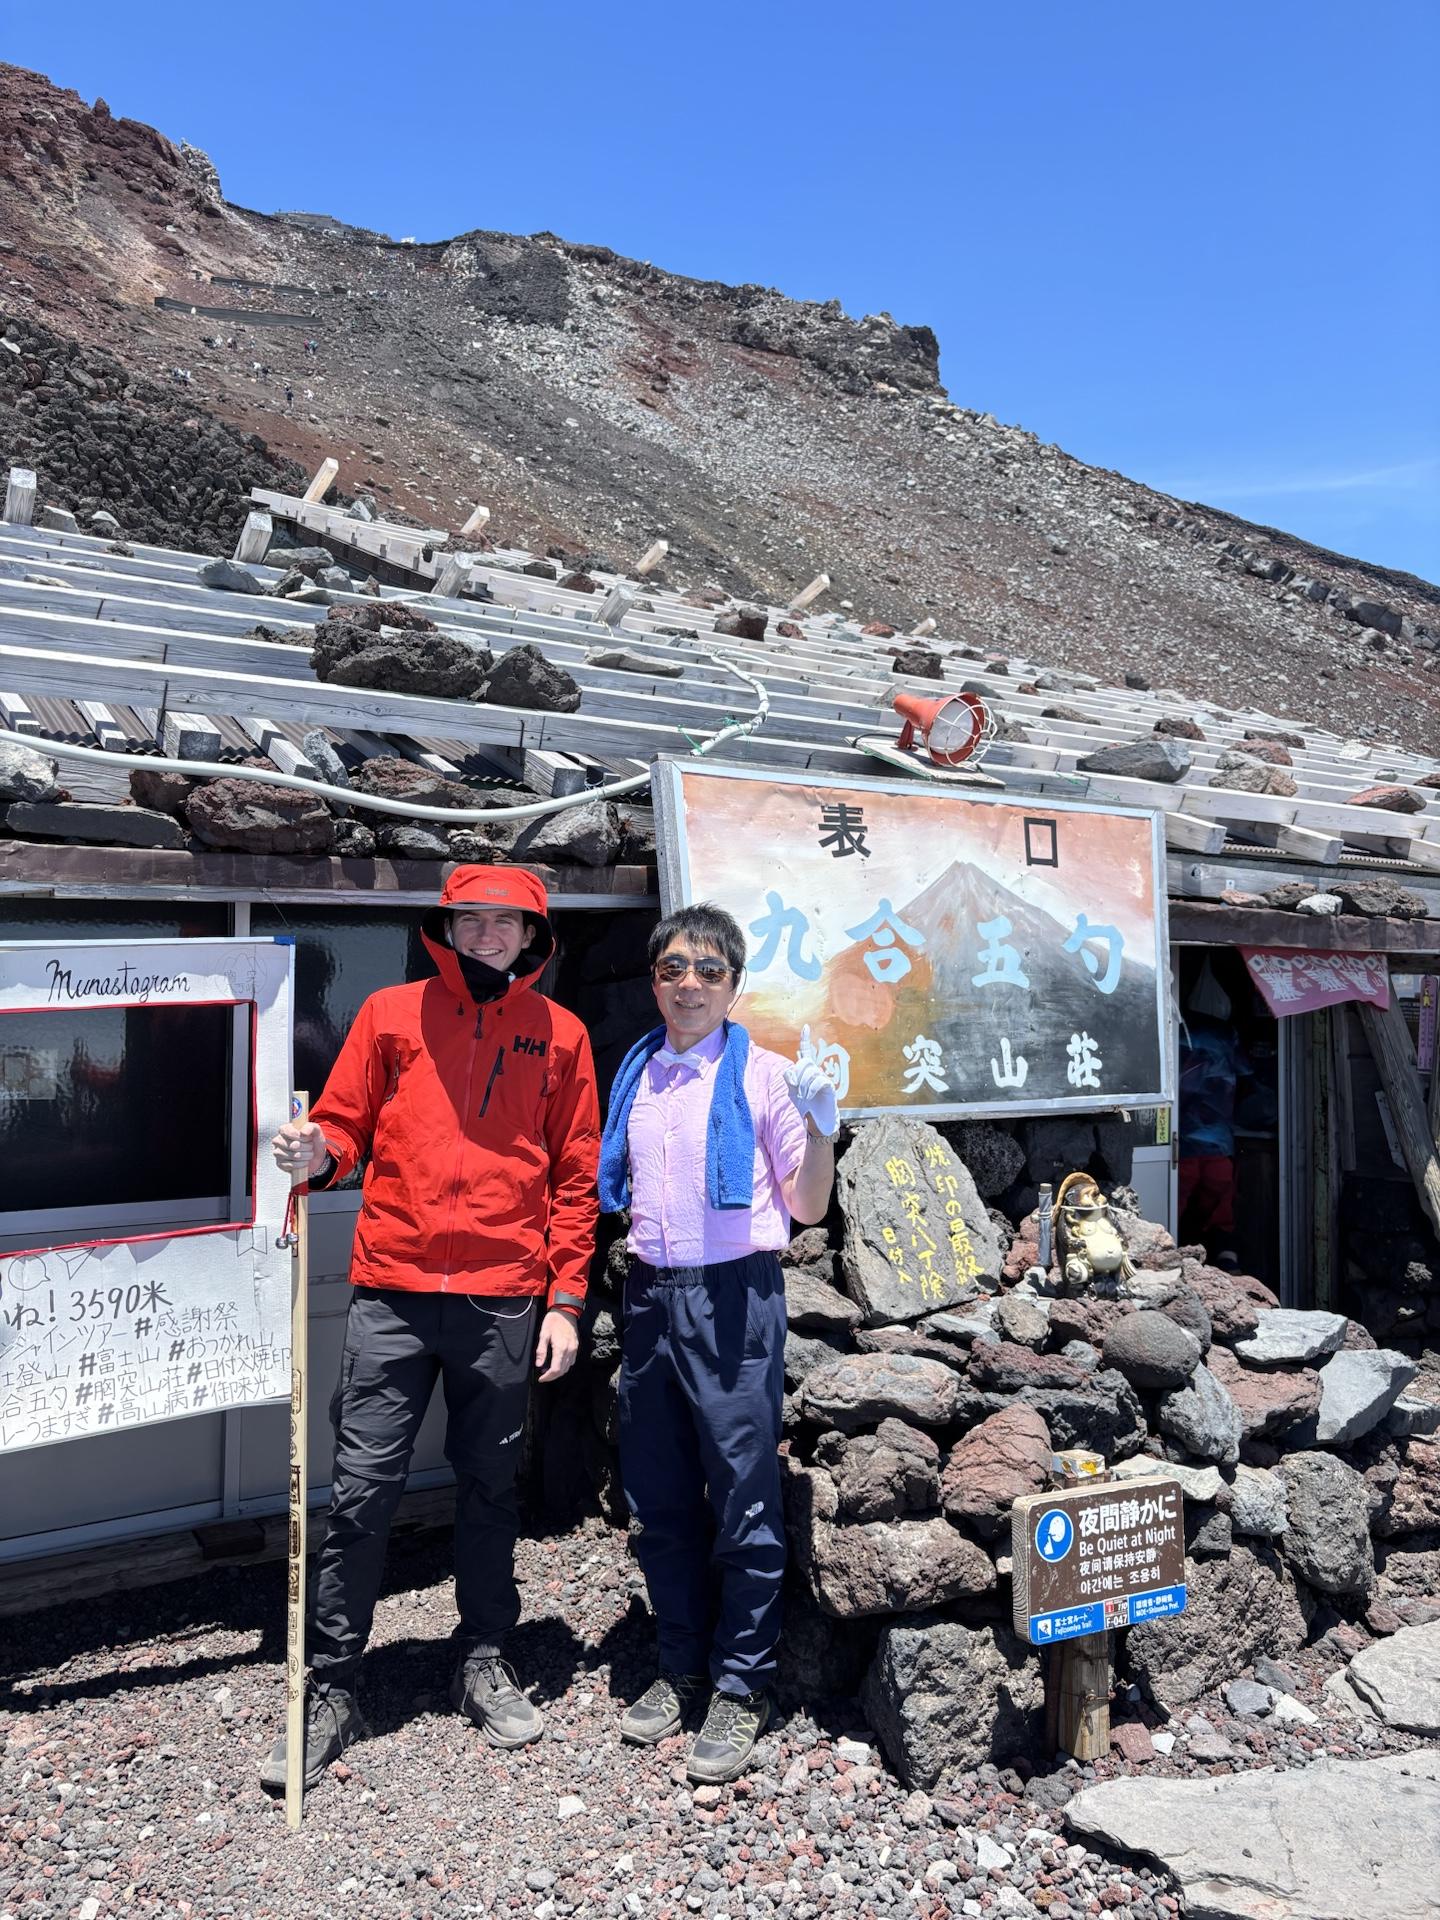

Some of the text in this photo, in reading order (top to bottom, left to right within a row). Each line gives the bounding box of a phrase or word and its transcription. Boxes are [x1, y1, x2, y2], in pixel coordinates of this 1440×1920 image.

[818, 803, 1059, 868] 表口
[748, 891, 1125, 994] 九合五勺
[45, 959, 190, 1003] Munastagram
[69, 1280, 173, 1322] 3590米
[79, 1346, 160, 1378] #富士山
[1078, 1494, 1177, 1538] 夜間静かに
[1079, 1526, 1176, 1557] Be Quiet at Night
[1079, 1548, 1157, 1577] 夜间请保持安静
[1080, 1565, 1160, 1595] 야간에는 조용히
[1106, 1615, 1128, 1628] F-047
